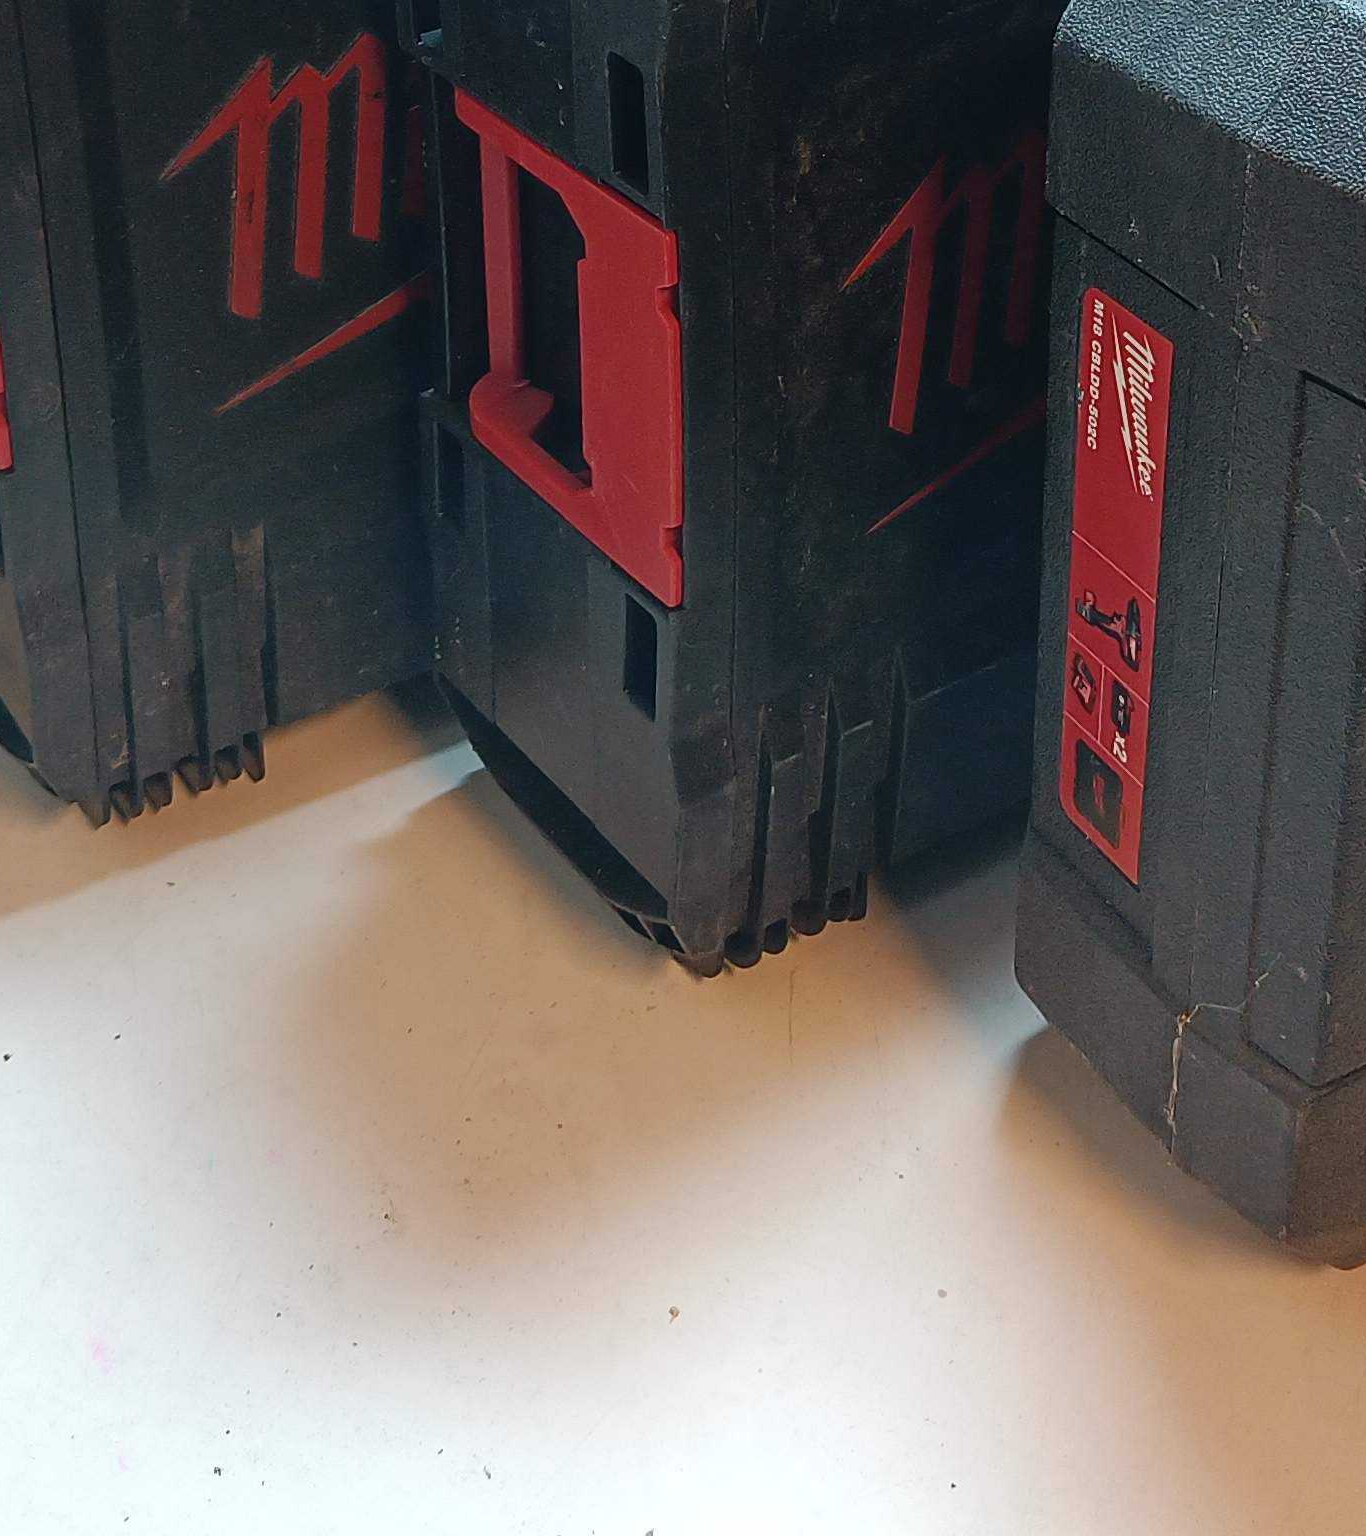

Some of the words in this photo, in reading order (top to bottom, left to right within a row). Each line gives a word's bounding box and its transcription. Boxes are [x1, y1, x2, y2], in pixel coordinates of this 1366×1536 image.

[1092, 298, 1105, 337] M18
[1086, 340, 1102, 450] CBLDD-502C
[1122, 330, 1157, 497] Milwaukee
